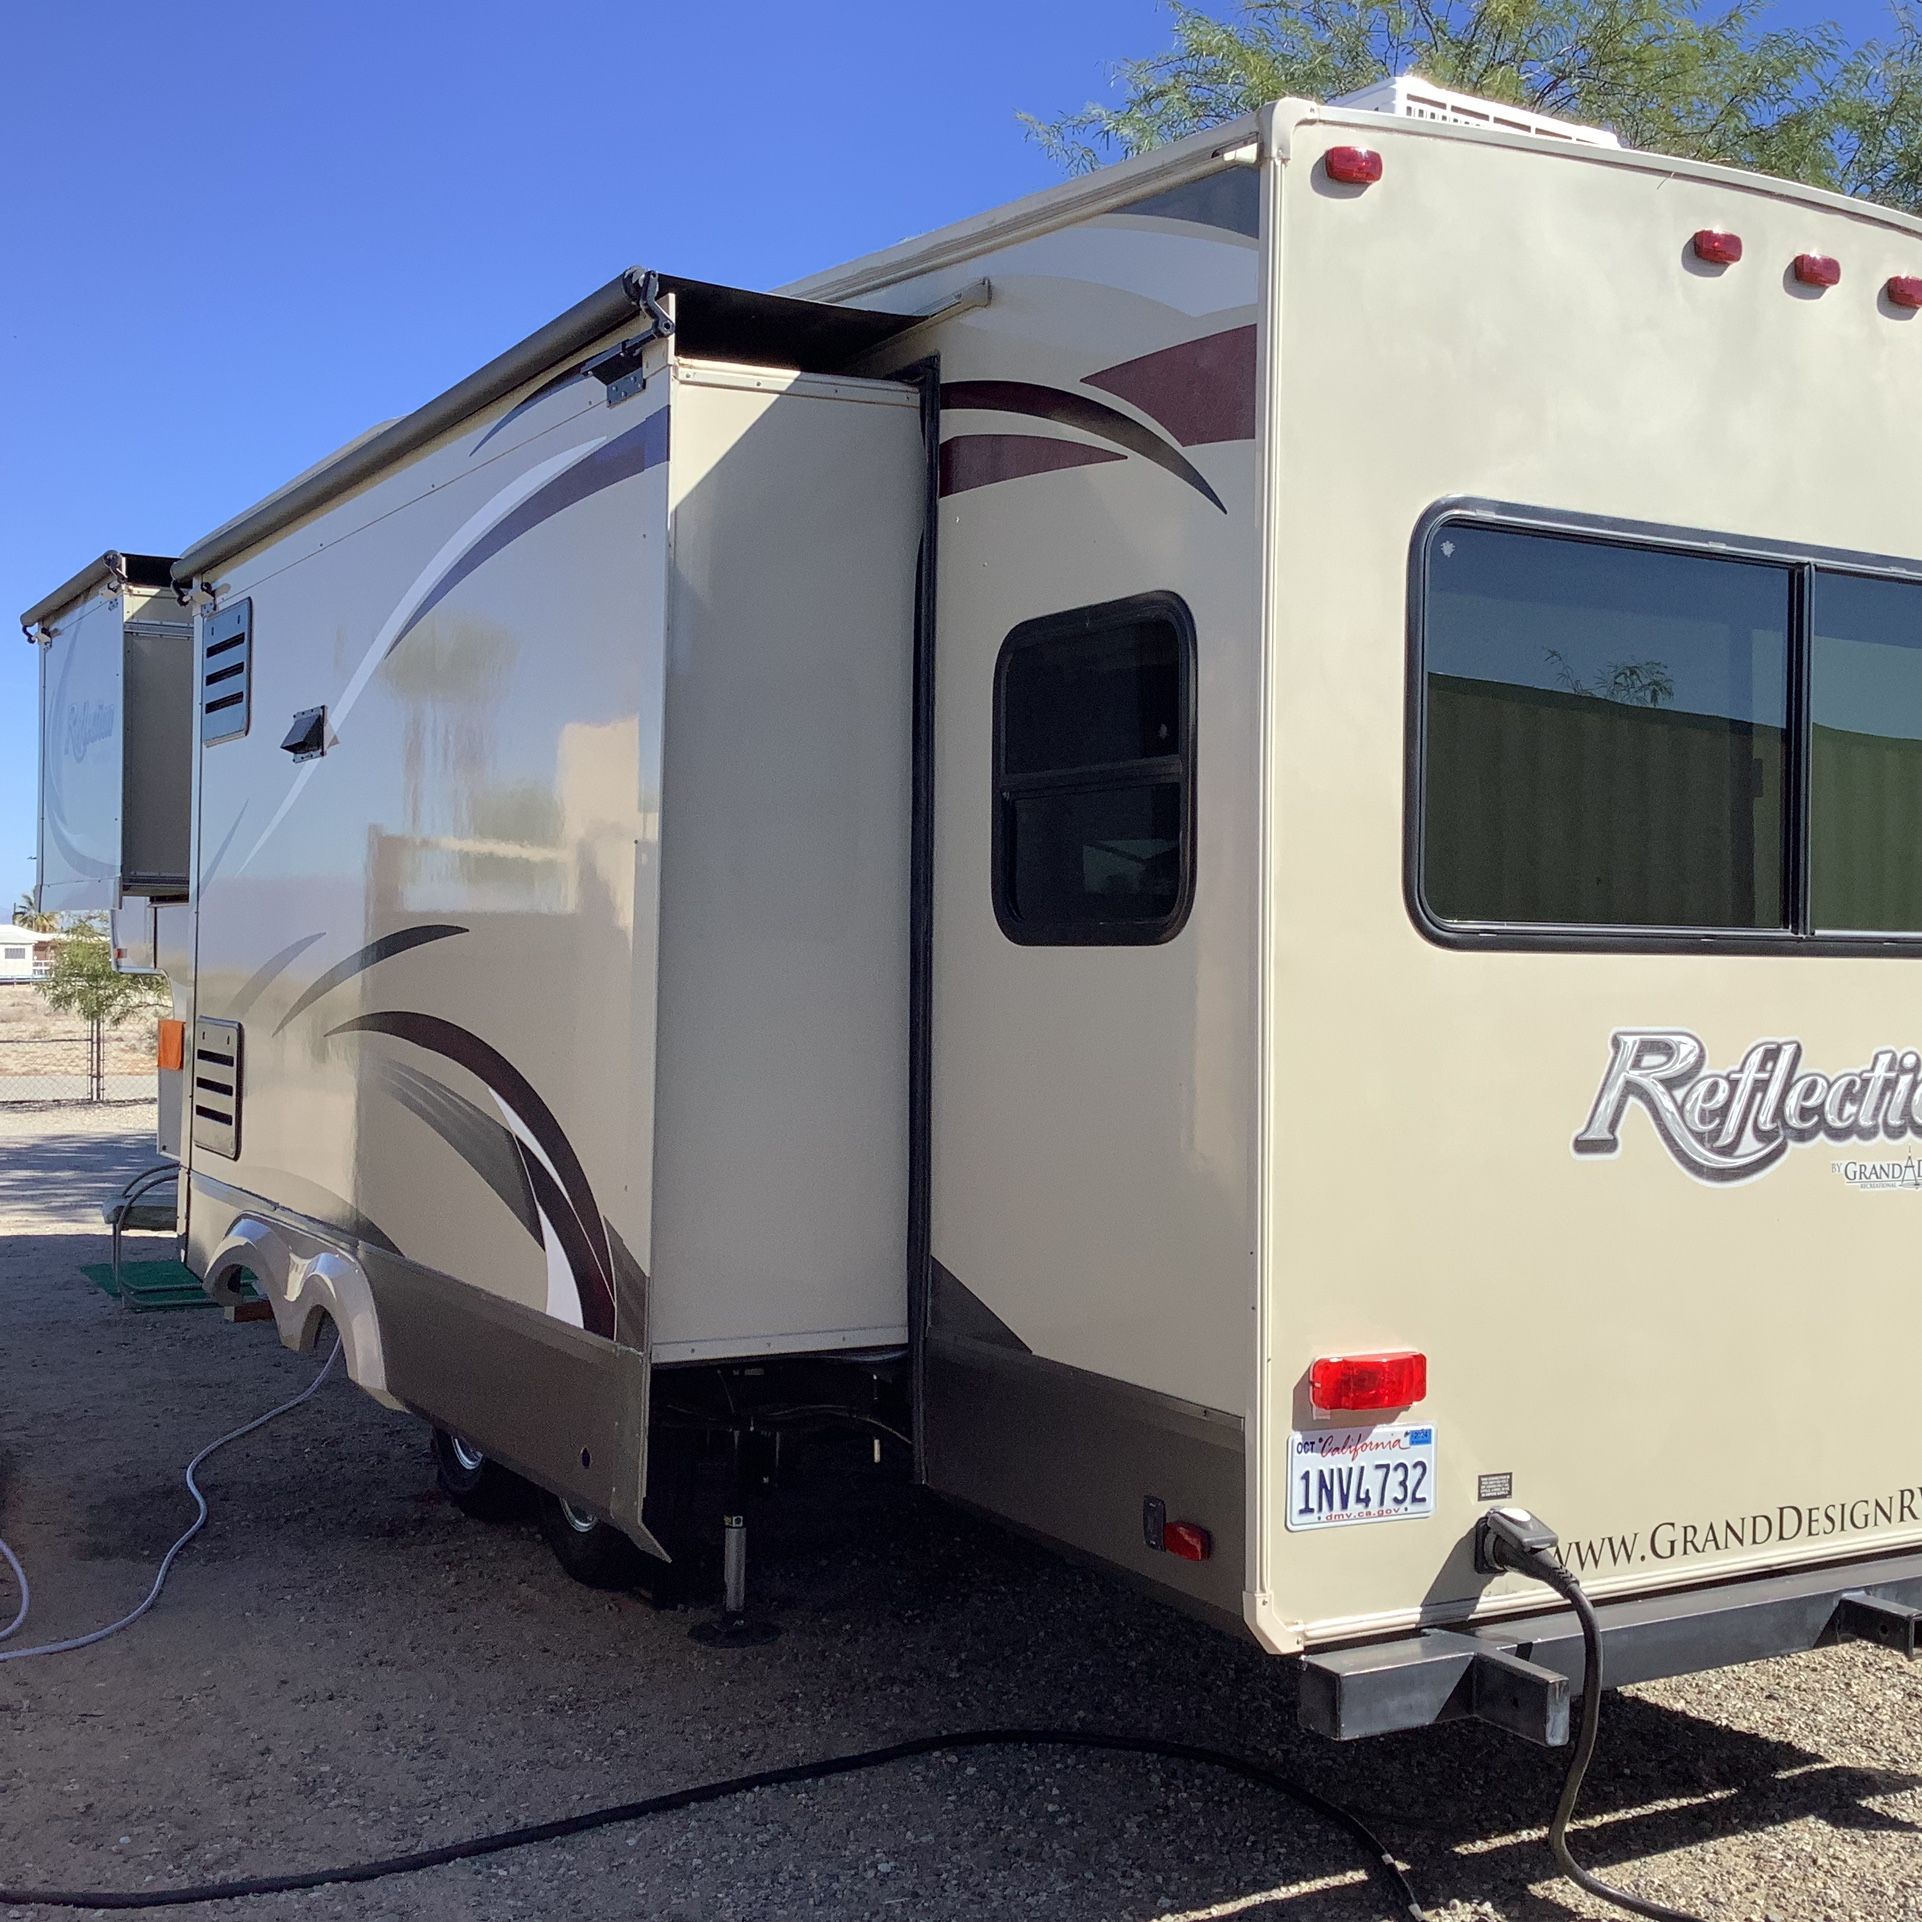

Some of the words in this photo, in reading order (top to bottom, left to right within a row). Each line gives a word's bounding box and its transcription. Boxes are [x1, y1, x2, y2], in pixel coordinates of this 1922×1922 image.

[1572, 1029, 1922, 1185] Reflecti
[1831, 1162, 1842, 1174] BY
[1296, 1441, 1316, 1455] OCT
[1319, 1433, 1411, 1462] California
[1298, 1460, 1428, 1516] 1NV4732
[1325, 1507, 1401, 1522] dmv.ca.gov
[1553, 1486, 1922, 1573] WWW.GRANDDESIGNR
